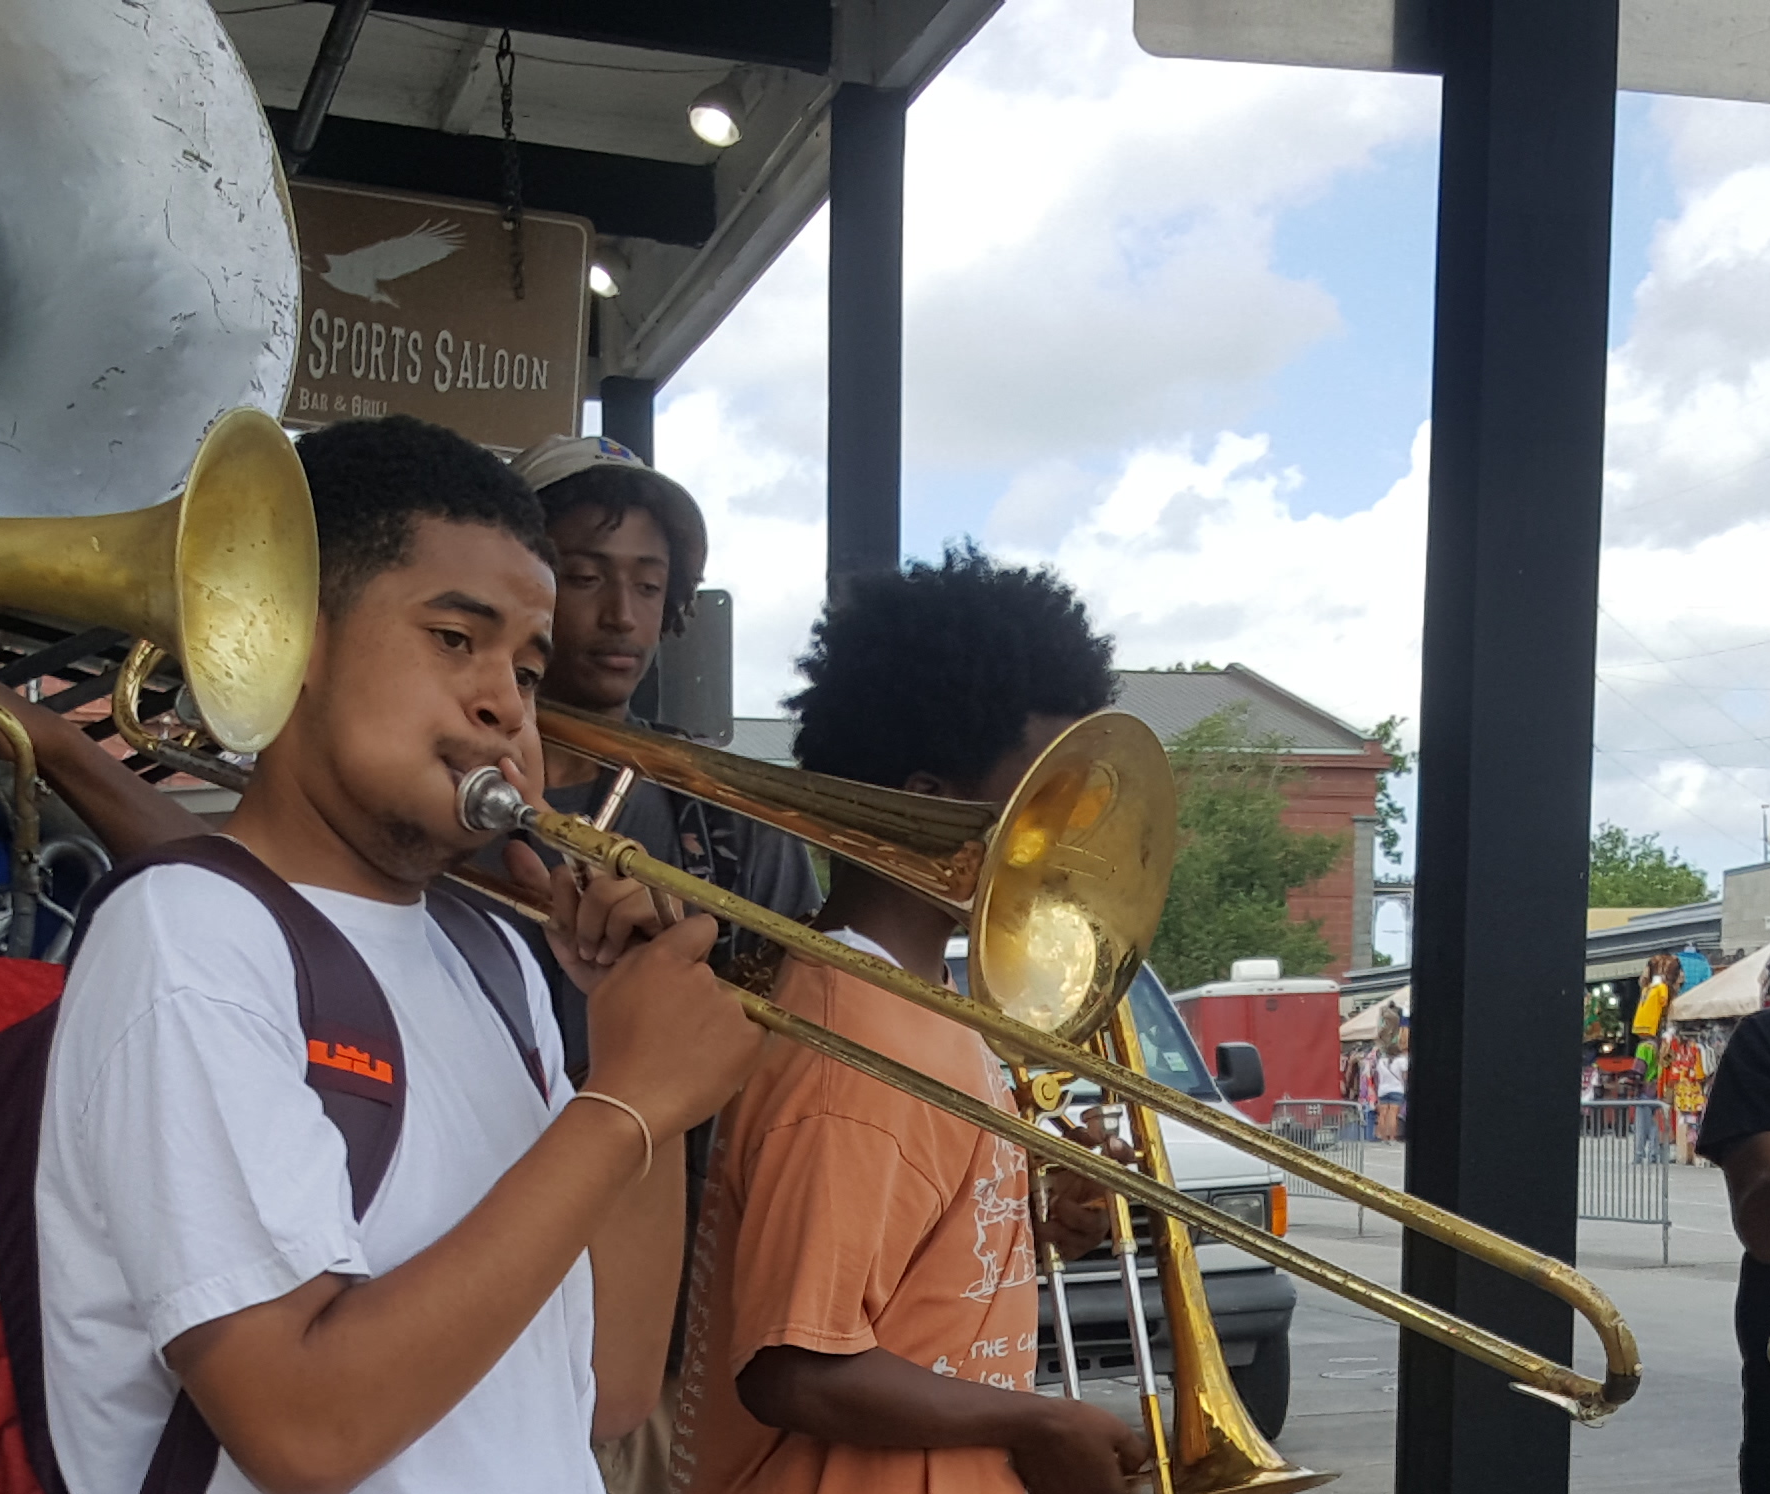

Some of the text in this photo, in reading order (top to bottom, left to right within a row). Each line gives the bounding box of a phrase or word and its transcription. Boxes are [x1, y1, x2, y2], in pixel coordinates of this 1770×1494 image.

[309, 308, 549, 393] SPORTS SALOON
[298, 386, 329, 411] BAR
[333, 394, 347, 412] &
[970, 1336, 1009, 1359] THE
